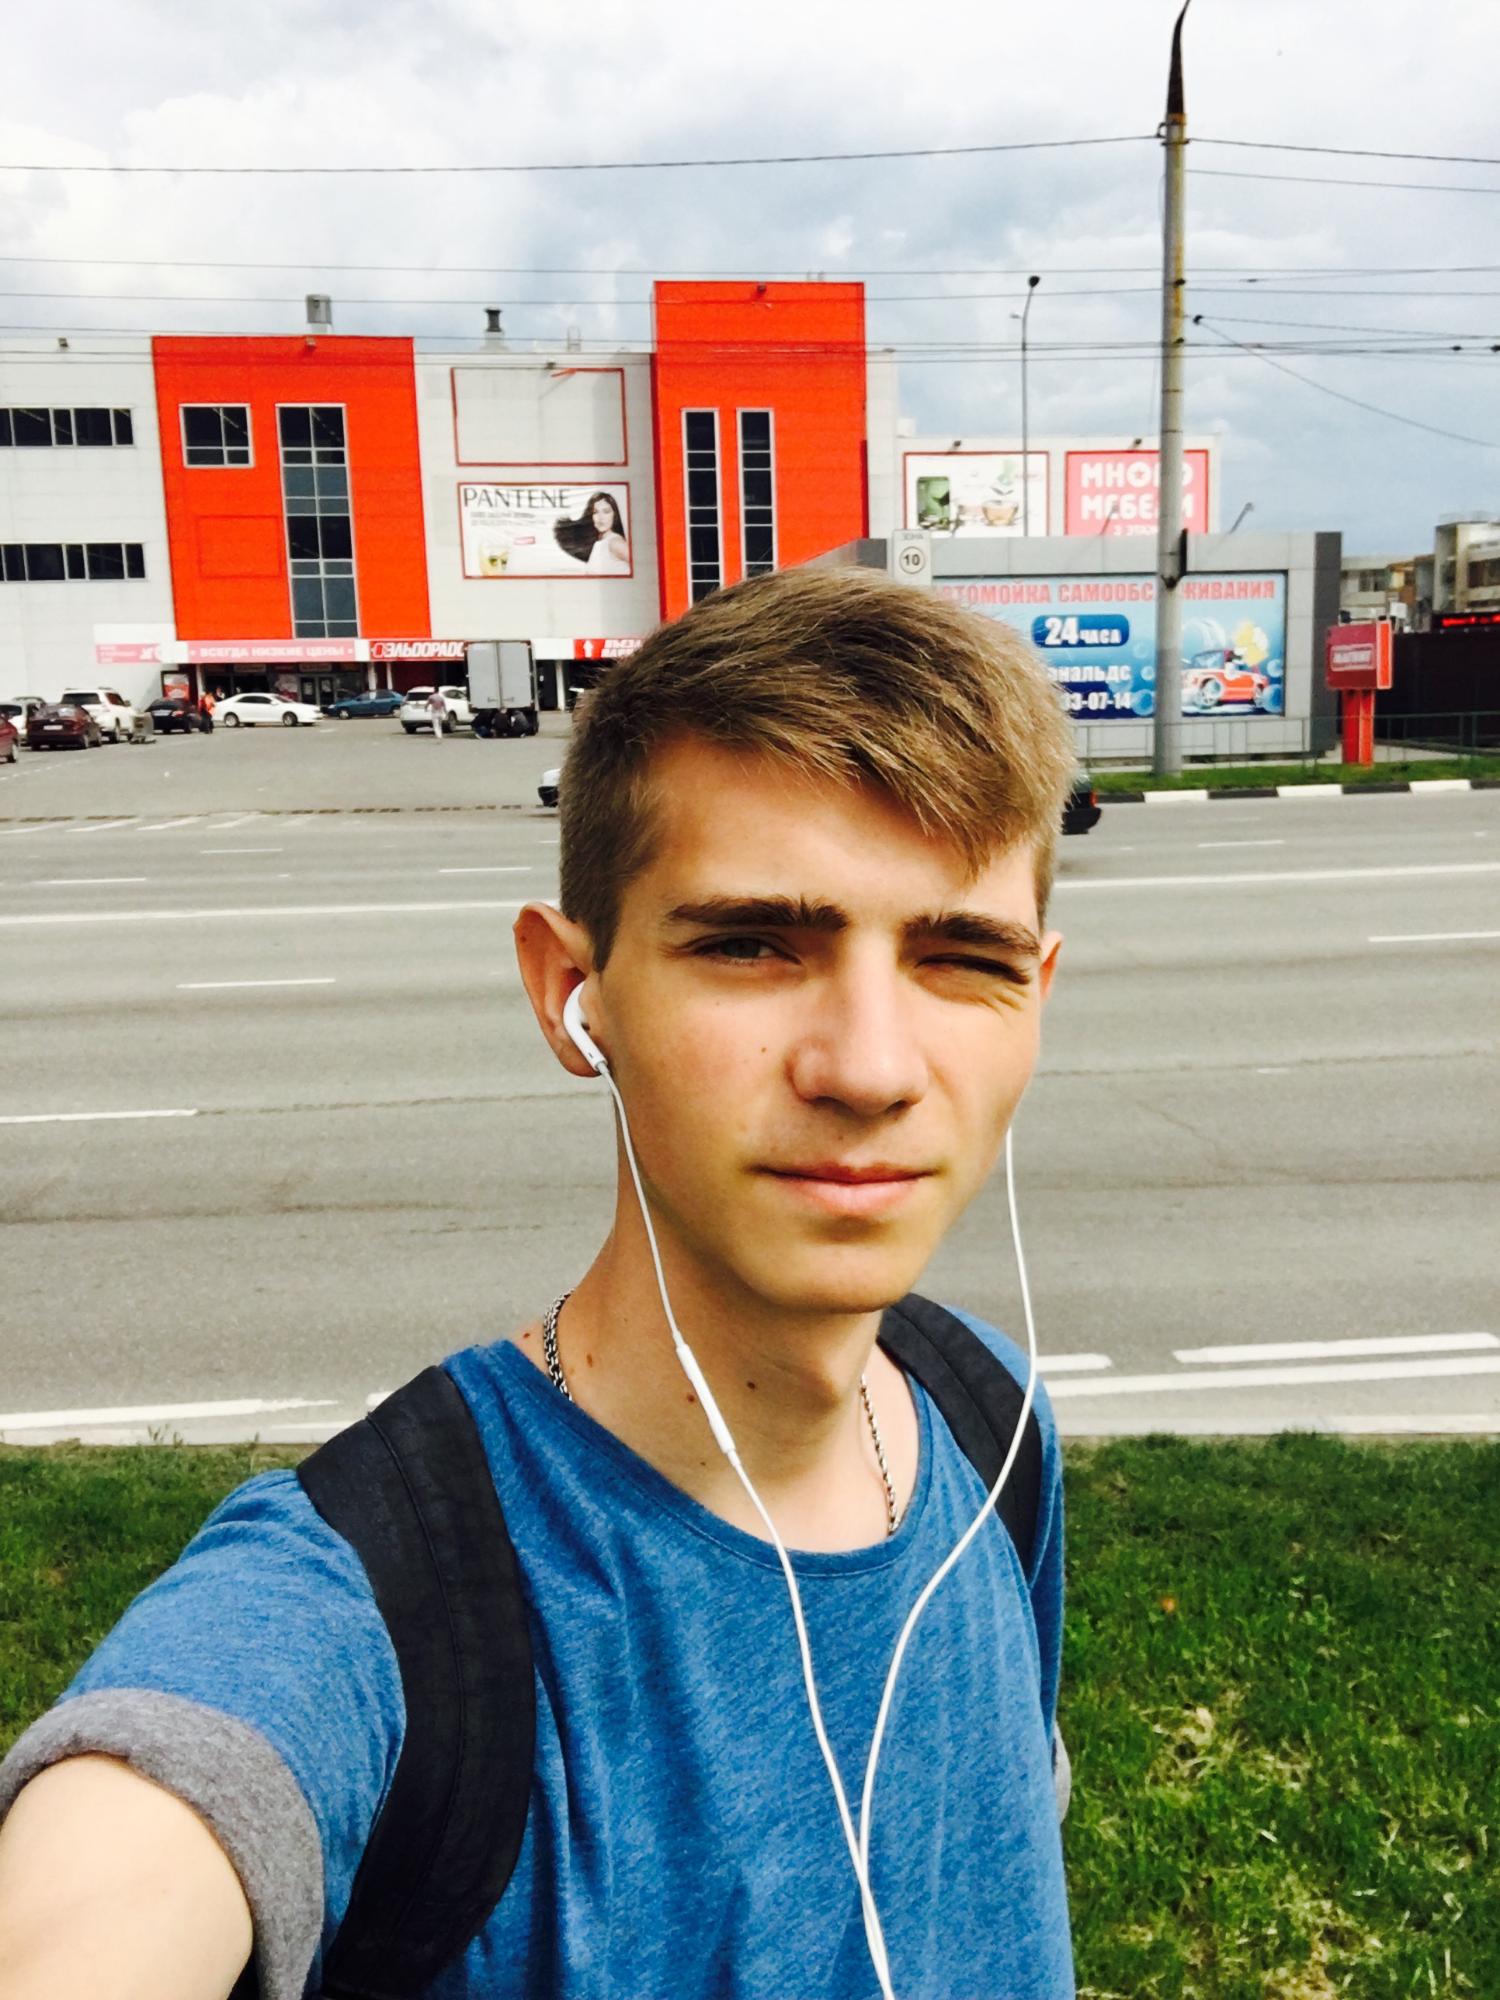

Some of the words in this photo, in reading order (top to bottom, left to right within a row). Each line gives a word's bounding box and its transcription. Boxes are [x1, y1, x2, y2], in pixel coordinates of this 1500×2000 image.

[1081, 461, 1194, 488] МНОО
[463, 487, 572, 509] PANTENE
[1081, 493, 1194, 520] МЕБЕИ
[904, 553, 921, 567] 10
[1044, 616, 1079, 646] 24
